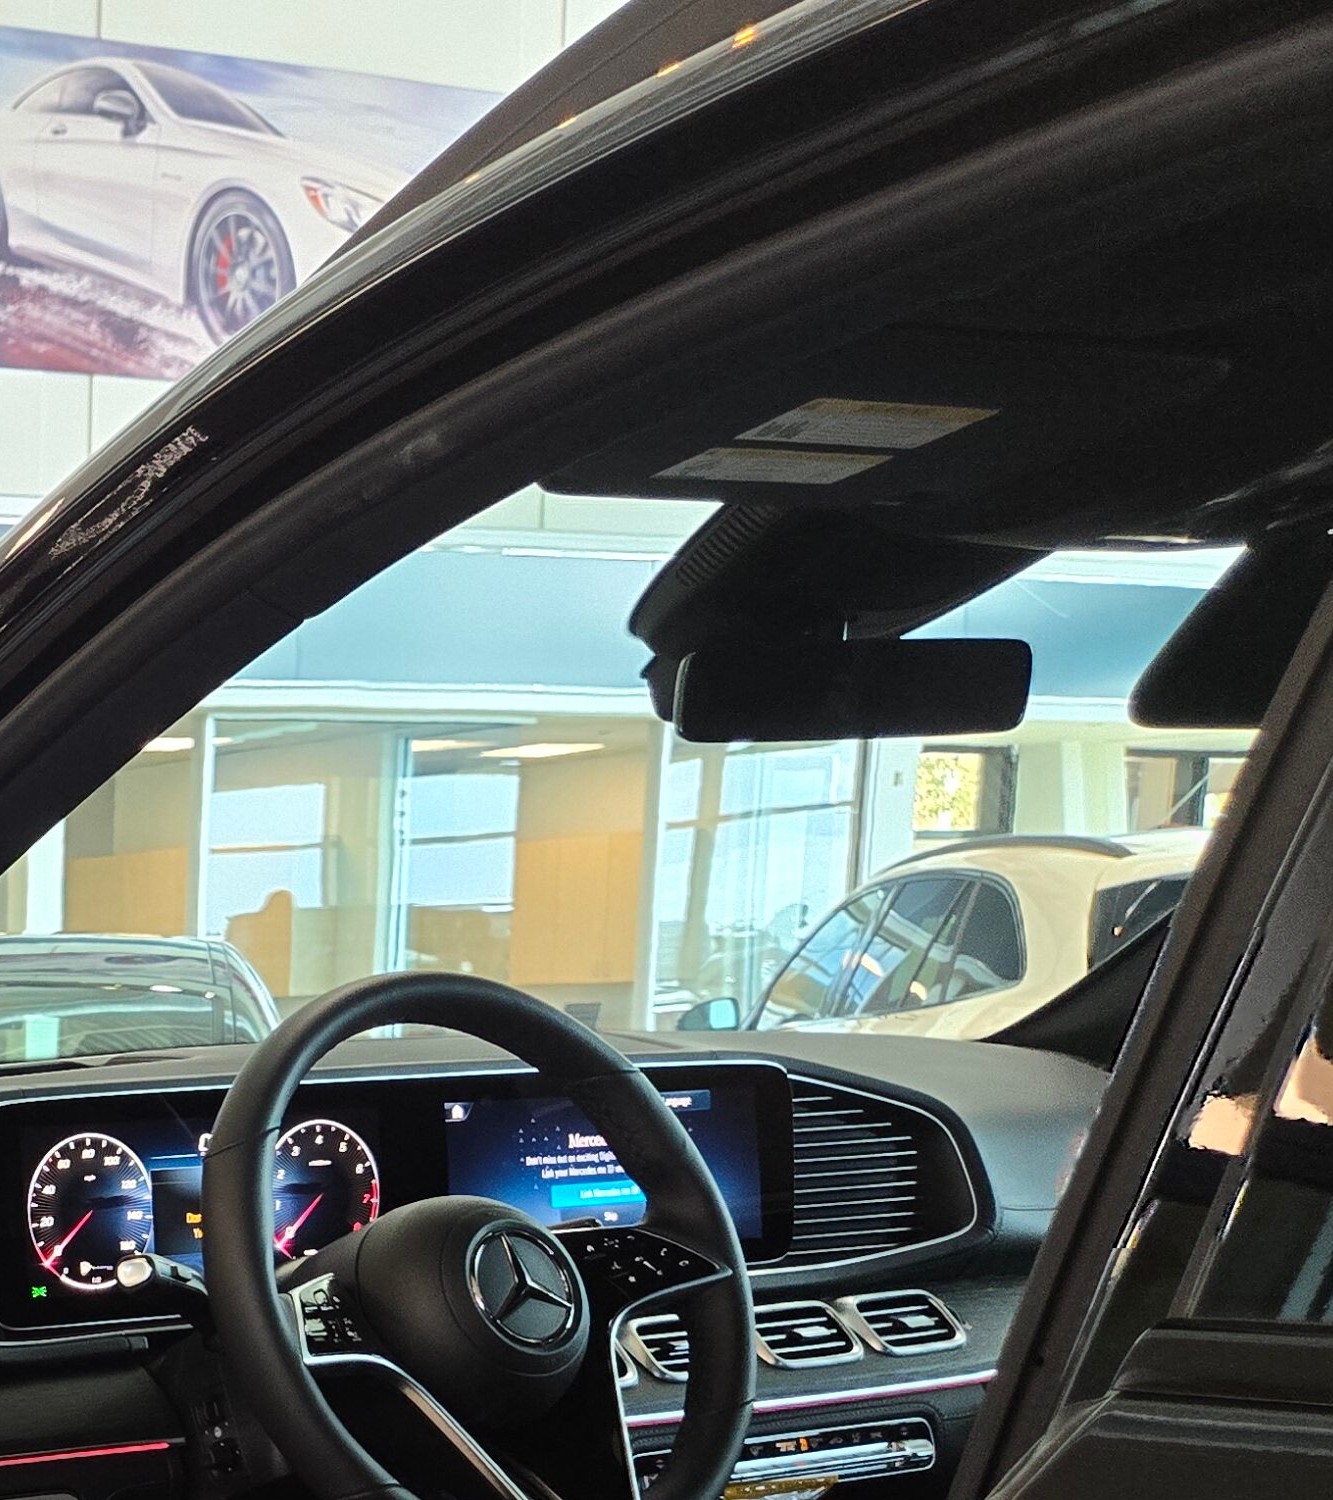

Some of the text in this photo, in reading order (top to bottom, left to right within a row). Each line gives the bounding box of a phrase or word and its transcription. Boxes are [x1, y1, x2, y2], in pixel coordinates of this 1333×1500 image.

[315, 1134, 323, 1145] 4
[291, 1145, 300, 1157] 3
[338, 1141, 347, 1153] 5
[355, 1163, 364, 1174] 6
[276, 1169, 285, 1180] 2
[40, 1216, 54, 1228] 20
